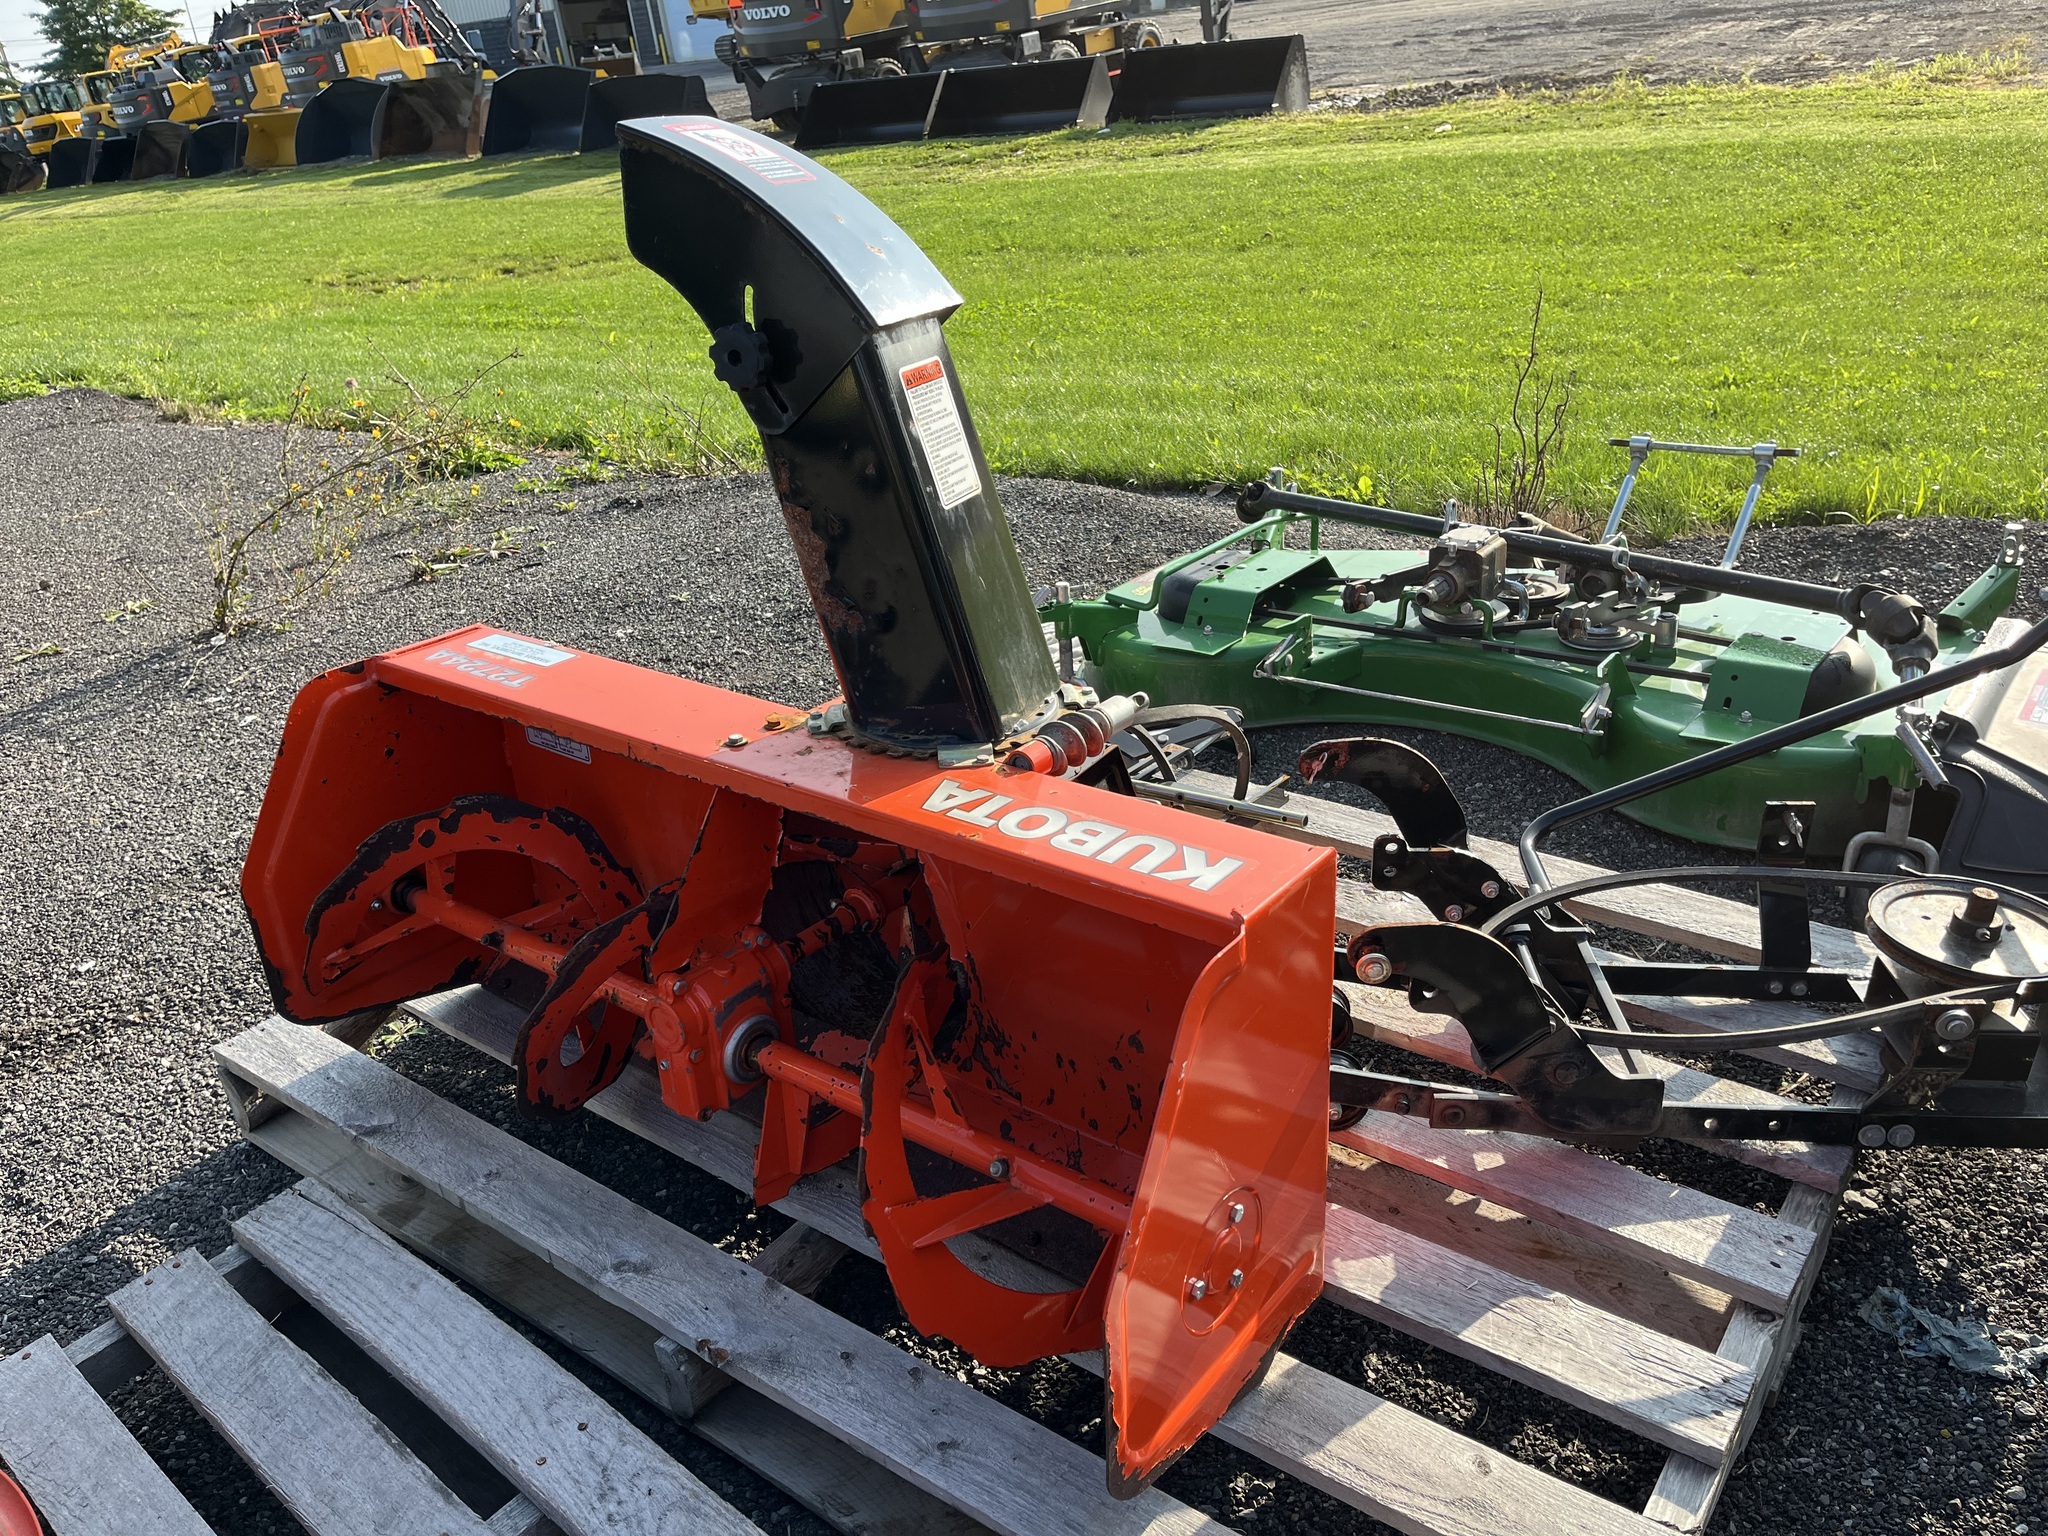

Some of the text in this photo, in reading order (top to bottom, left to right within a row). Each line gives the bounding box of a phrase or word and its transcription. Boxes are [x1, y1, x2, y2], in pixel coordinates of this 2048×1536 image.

[743, 5, 791, 20] VOLVO
[123, 52, 140, 62] JCB
[911, 363, 942, 384] WARNING
[922, 779, 1245, 891] KUBOTA
